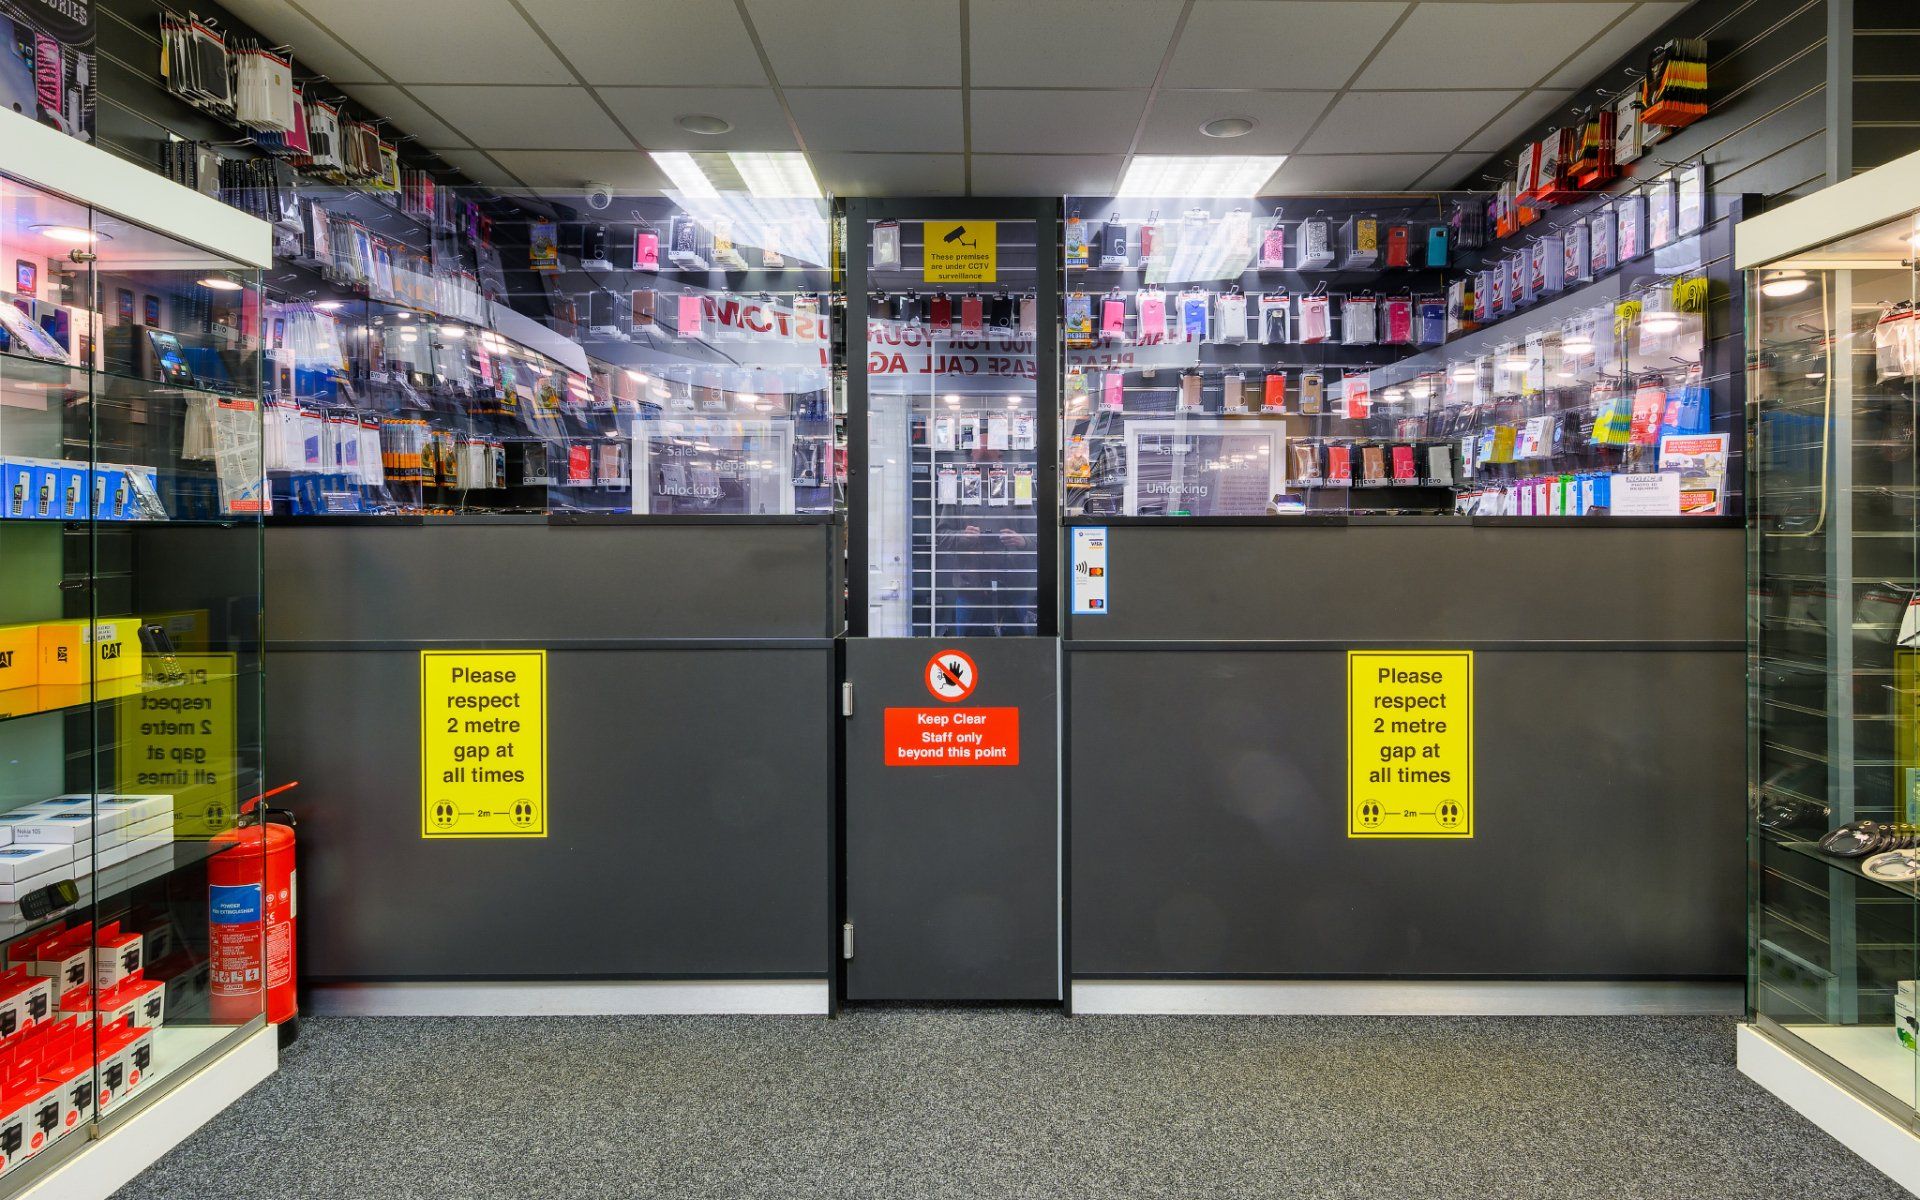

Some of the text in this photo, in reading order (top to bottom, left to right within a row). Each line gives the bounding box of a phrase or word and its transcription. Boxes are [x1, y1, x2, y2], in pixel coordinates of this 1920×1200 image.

[956, 253, 989, 261] premises
[946, 262, 966, 270] under
[968, 262, 989, 270] CCTV
[213, 324, 227, 334] EVO
[667, 445, 698, 457] Sales
[716, 459, 760, 472] Repairs
[658, 484, 720, 499] Unlocking
[1146, 483, 1208, 497] Unlocking
[57, 646, 67, 662] CAT
[101, 642, 122, 660] CAT
[0, 651, 14, 669] AT
[452, 667, 516, 683] Please
[1378, 667, 1443, 684] Please
[448, 693, 520, 712] respect
[1374, 694, 1446, 712] respect
[447, 718, 520, 733] 2 metre
[917, 713, 986, 727] Keep Clear
[1374, 718, 1447, 733] 2 metre
[922, 732, 982, 745] Staff only
[454, 742, 514, 762] gap at
[898, 747, 1007, 759] beyond this point
[1380, 743, 1440, 762] gap at
[443, 767, 525, 783] all times
[1369, 767, 1451, 783] all times
